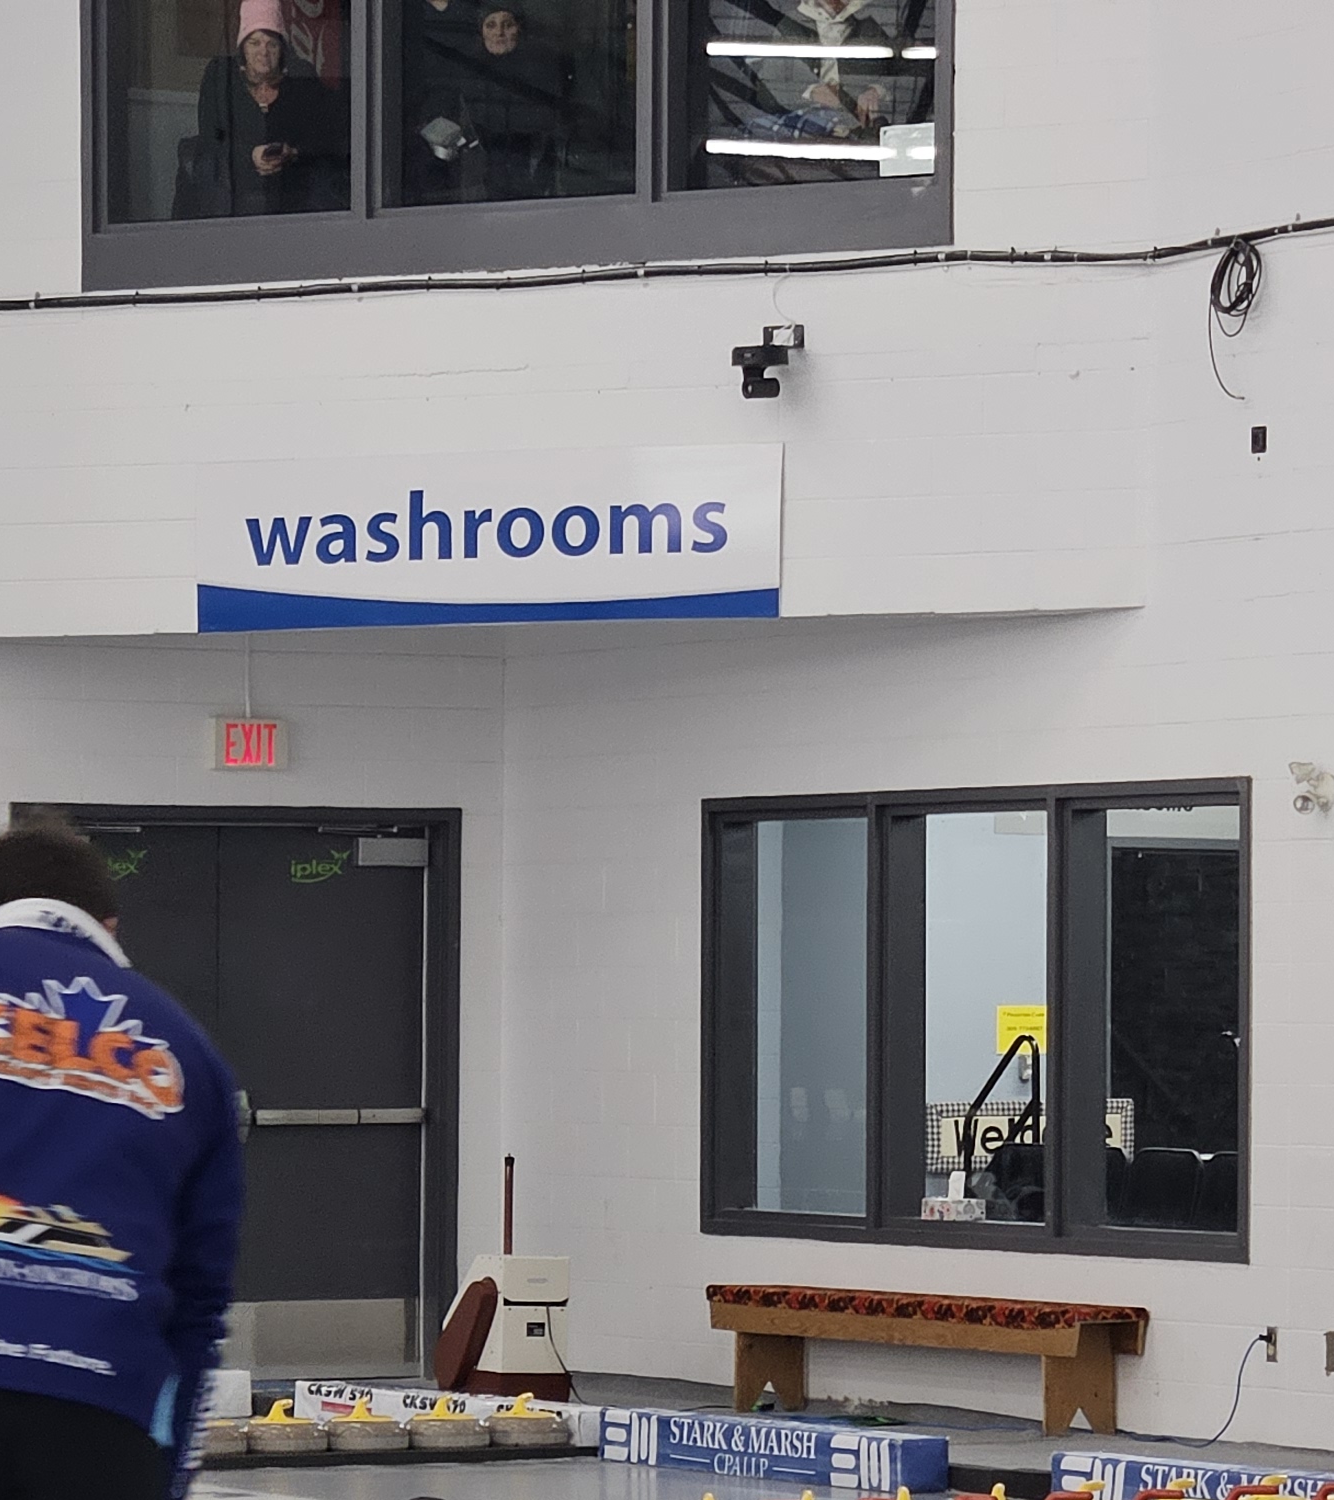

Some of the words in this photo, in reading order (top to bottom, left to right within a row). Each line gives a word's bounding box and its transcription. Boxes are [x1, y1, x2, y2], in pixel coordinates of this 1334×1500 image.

[245, 489, 729, 567] washrooms
[224, 723, 278, 766] EXIT
[291, 856, 345, 881] iplex
[307, 1383, 343, 1399] CKSW
[669, 1416, 729, 1451] STARK
[731, 1424, 746, 1453] &
[748, 1426, 818, 1460] MARSH
[1216, 1472, 1234, 1500] &
